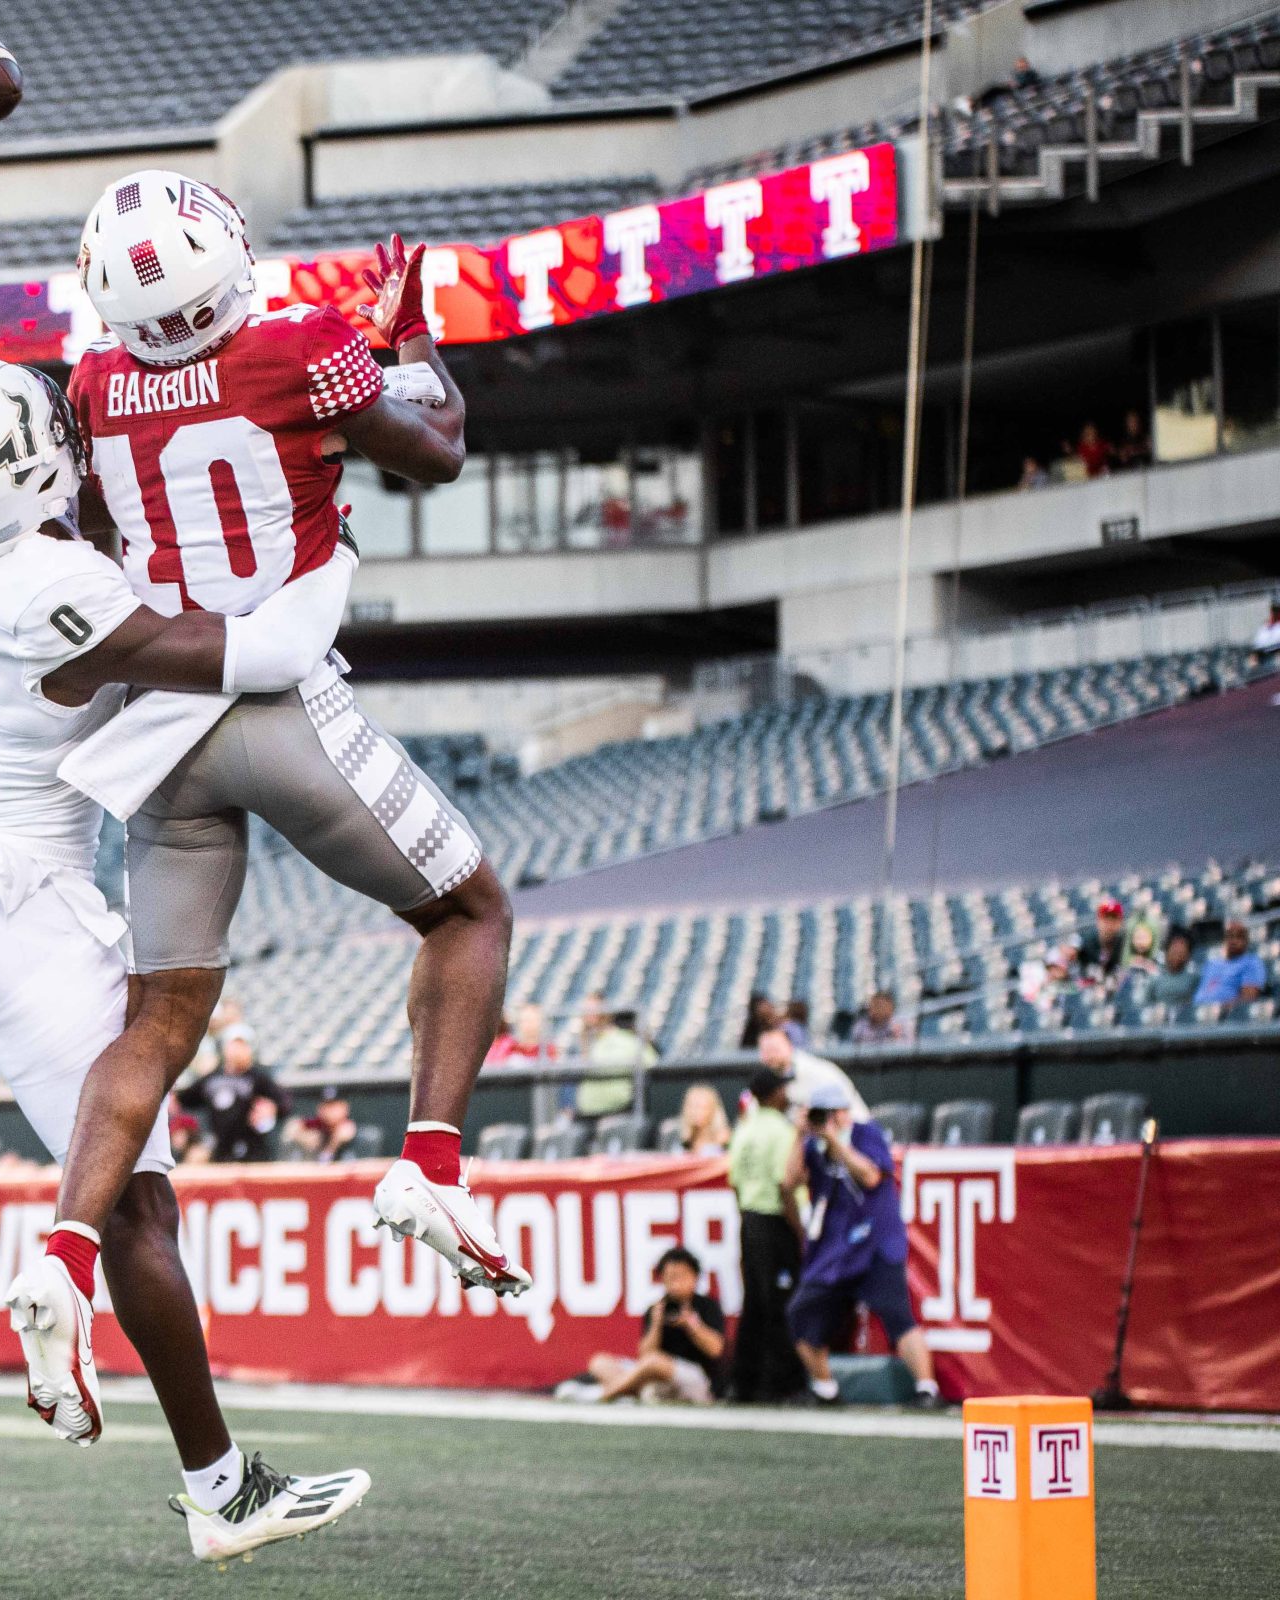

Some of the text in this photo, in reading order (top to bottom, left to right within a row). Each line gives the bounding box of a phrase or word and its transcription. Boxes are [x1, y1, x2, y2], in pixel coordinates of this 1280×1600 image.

[507, 229, 563, 330] T
[604, 204, 661, 309] T
[704, 179, 763, 283] T
[809, 150, 870, 260] T
[147, 330, 234, 366] TEMPLE
[107, 359, 220, 417] BARBON
[93, 416, 296, 618] 10
[48, 603, 94, 646] 0
[901, 1150, 1016, 1352] T
[974, 1429, 1009, 1495] T
[1038, 1429, 1080, 1494] T
